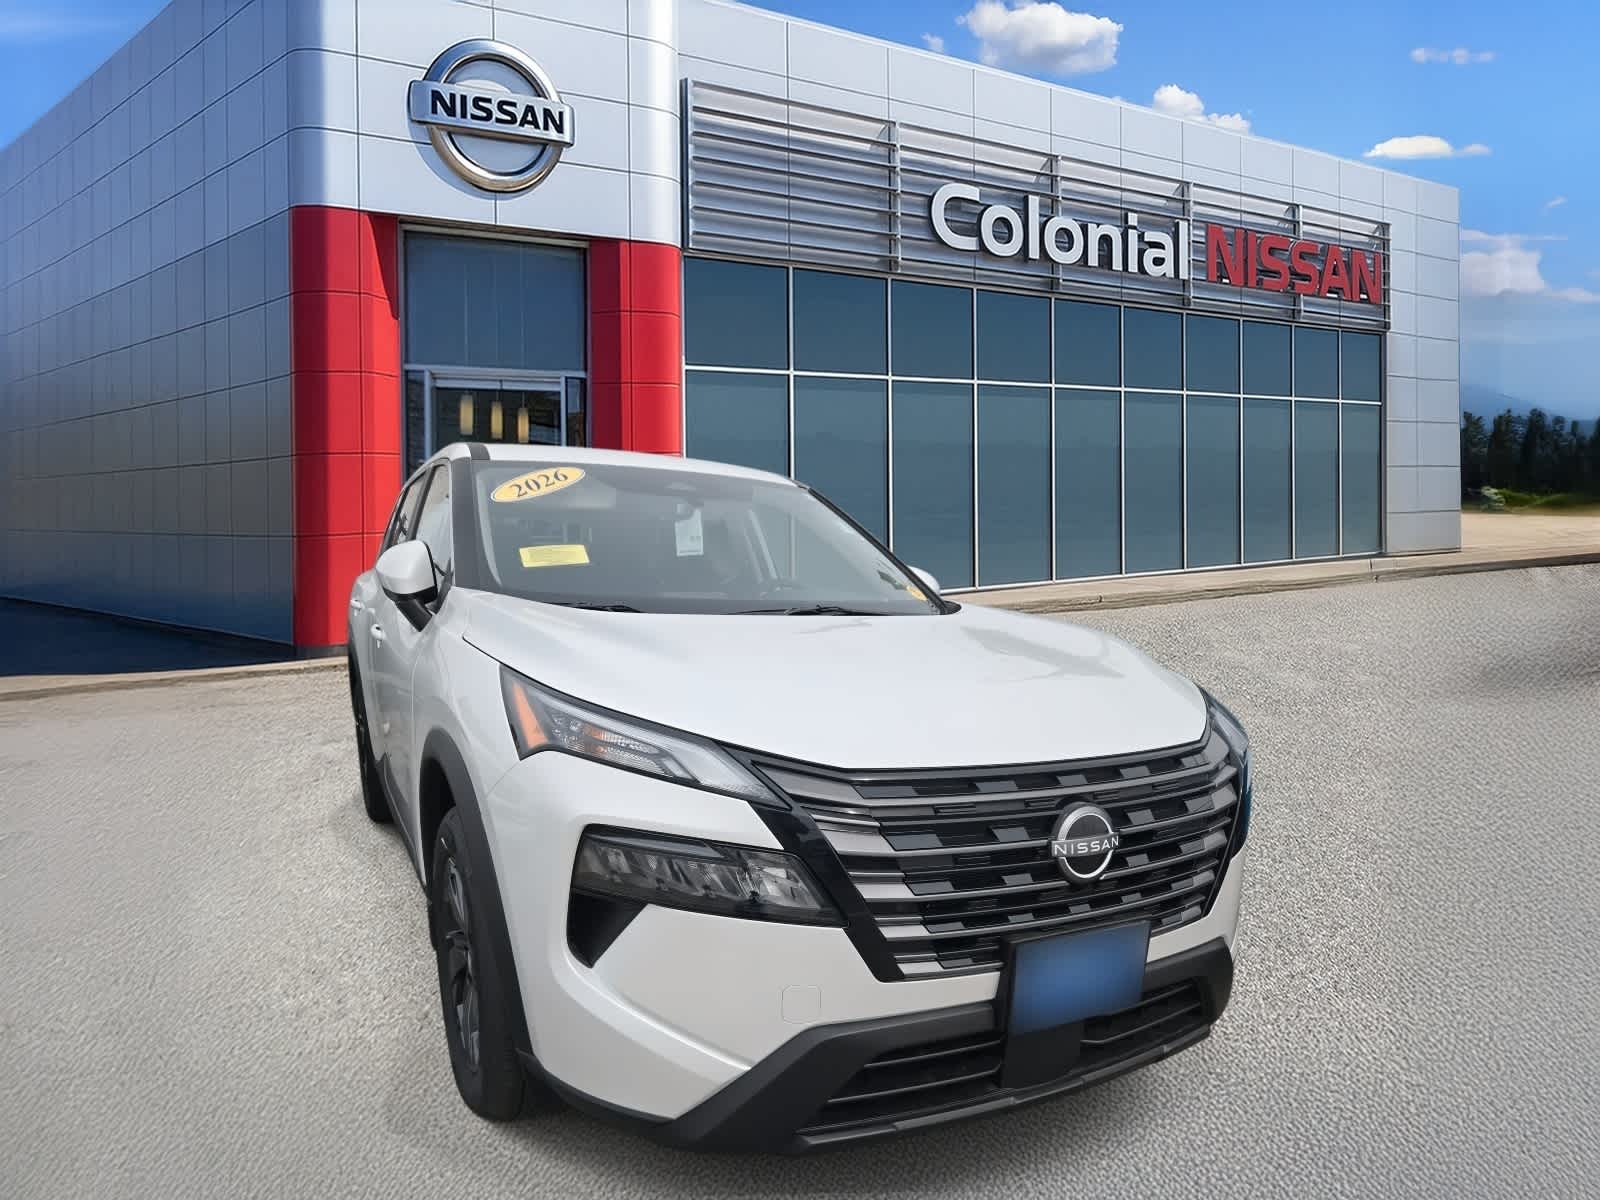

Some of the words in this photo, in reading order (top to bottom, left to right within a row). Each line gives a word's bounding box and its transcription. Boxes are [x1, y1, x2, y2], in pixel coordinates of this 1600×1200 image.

[430, 89, 564, 134] NISSAN
[930, 183, 1189, 280] Colonial
[1206, 224, 1382, 304] NISSAN
[509, 468, 569, 498] 2026
[1054, 836, 1119, 855] NISSAN
